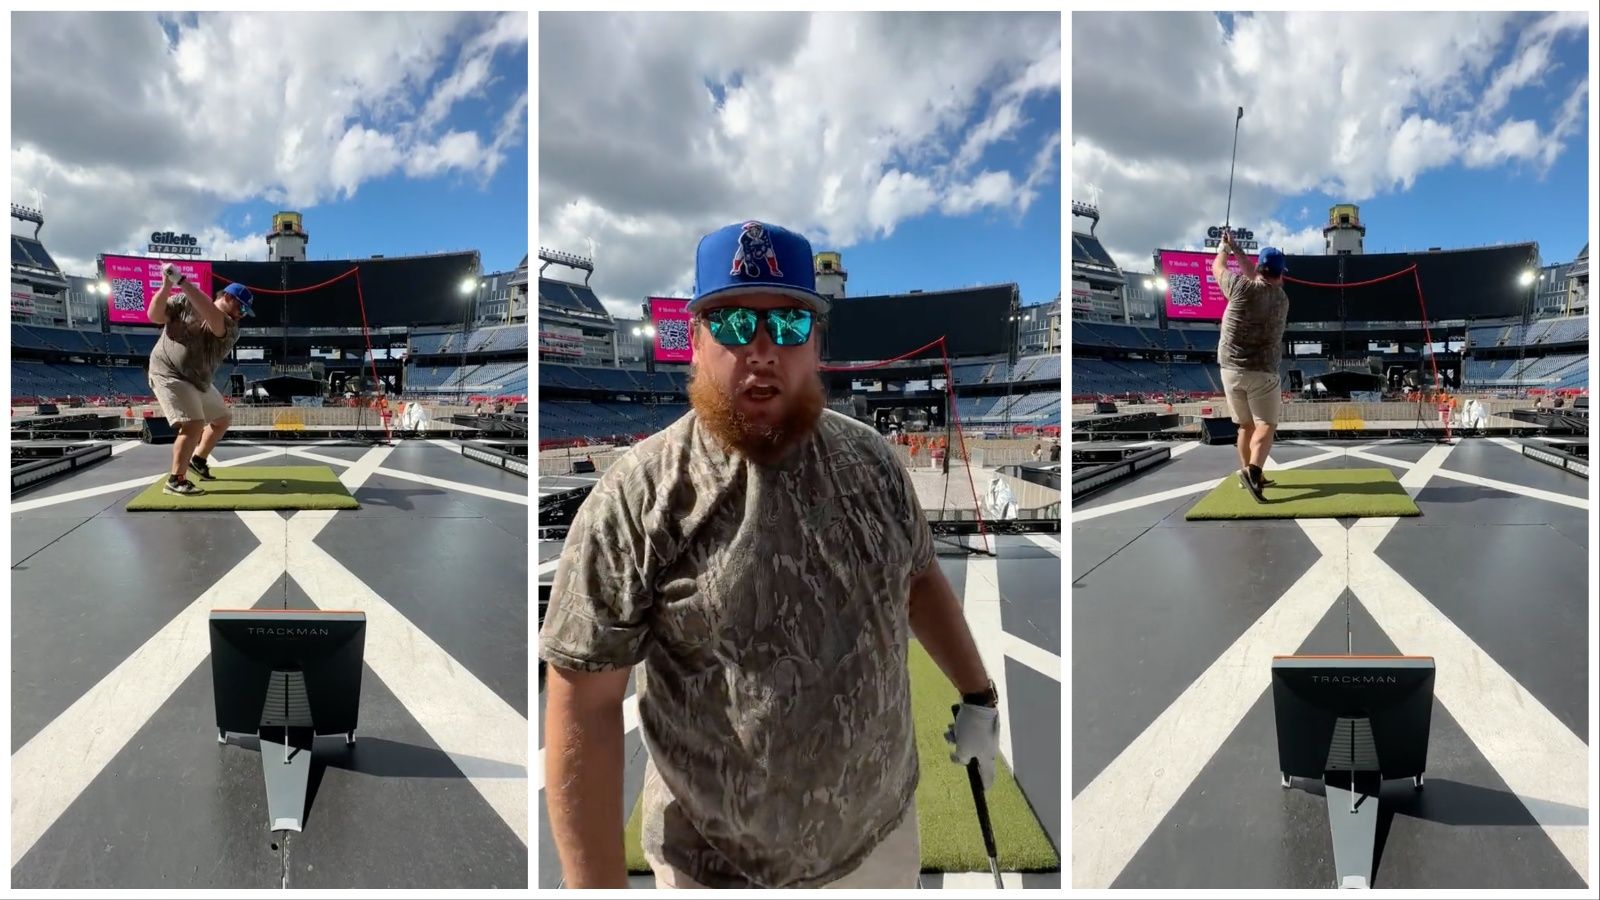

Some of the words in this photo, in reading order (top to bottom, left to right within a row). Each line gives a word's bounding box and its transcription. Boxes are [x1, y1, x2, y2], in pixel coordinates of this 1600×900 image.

[151, 231, 197, 246] Gillette
[150, 245, 200, 254] STADIUM
[247, 627, 329, 636] TRACKMAN
[1311, 675, 1396, 684] TRACKMAN
